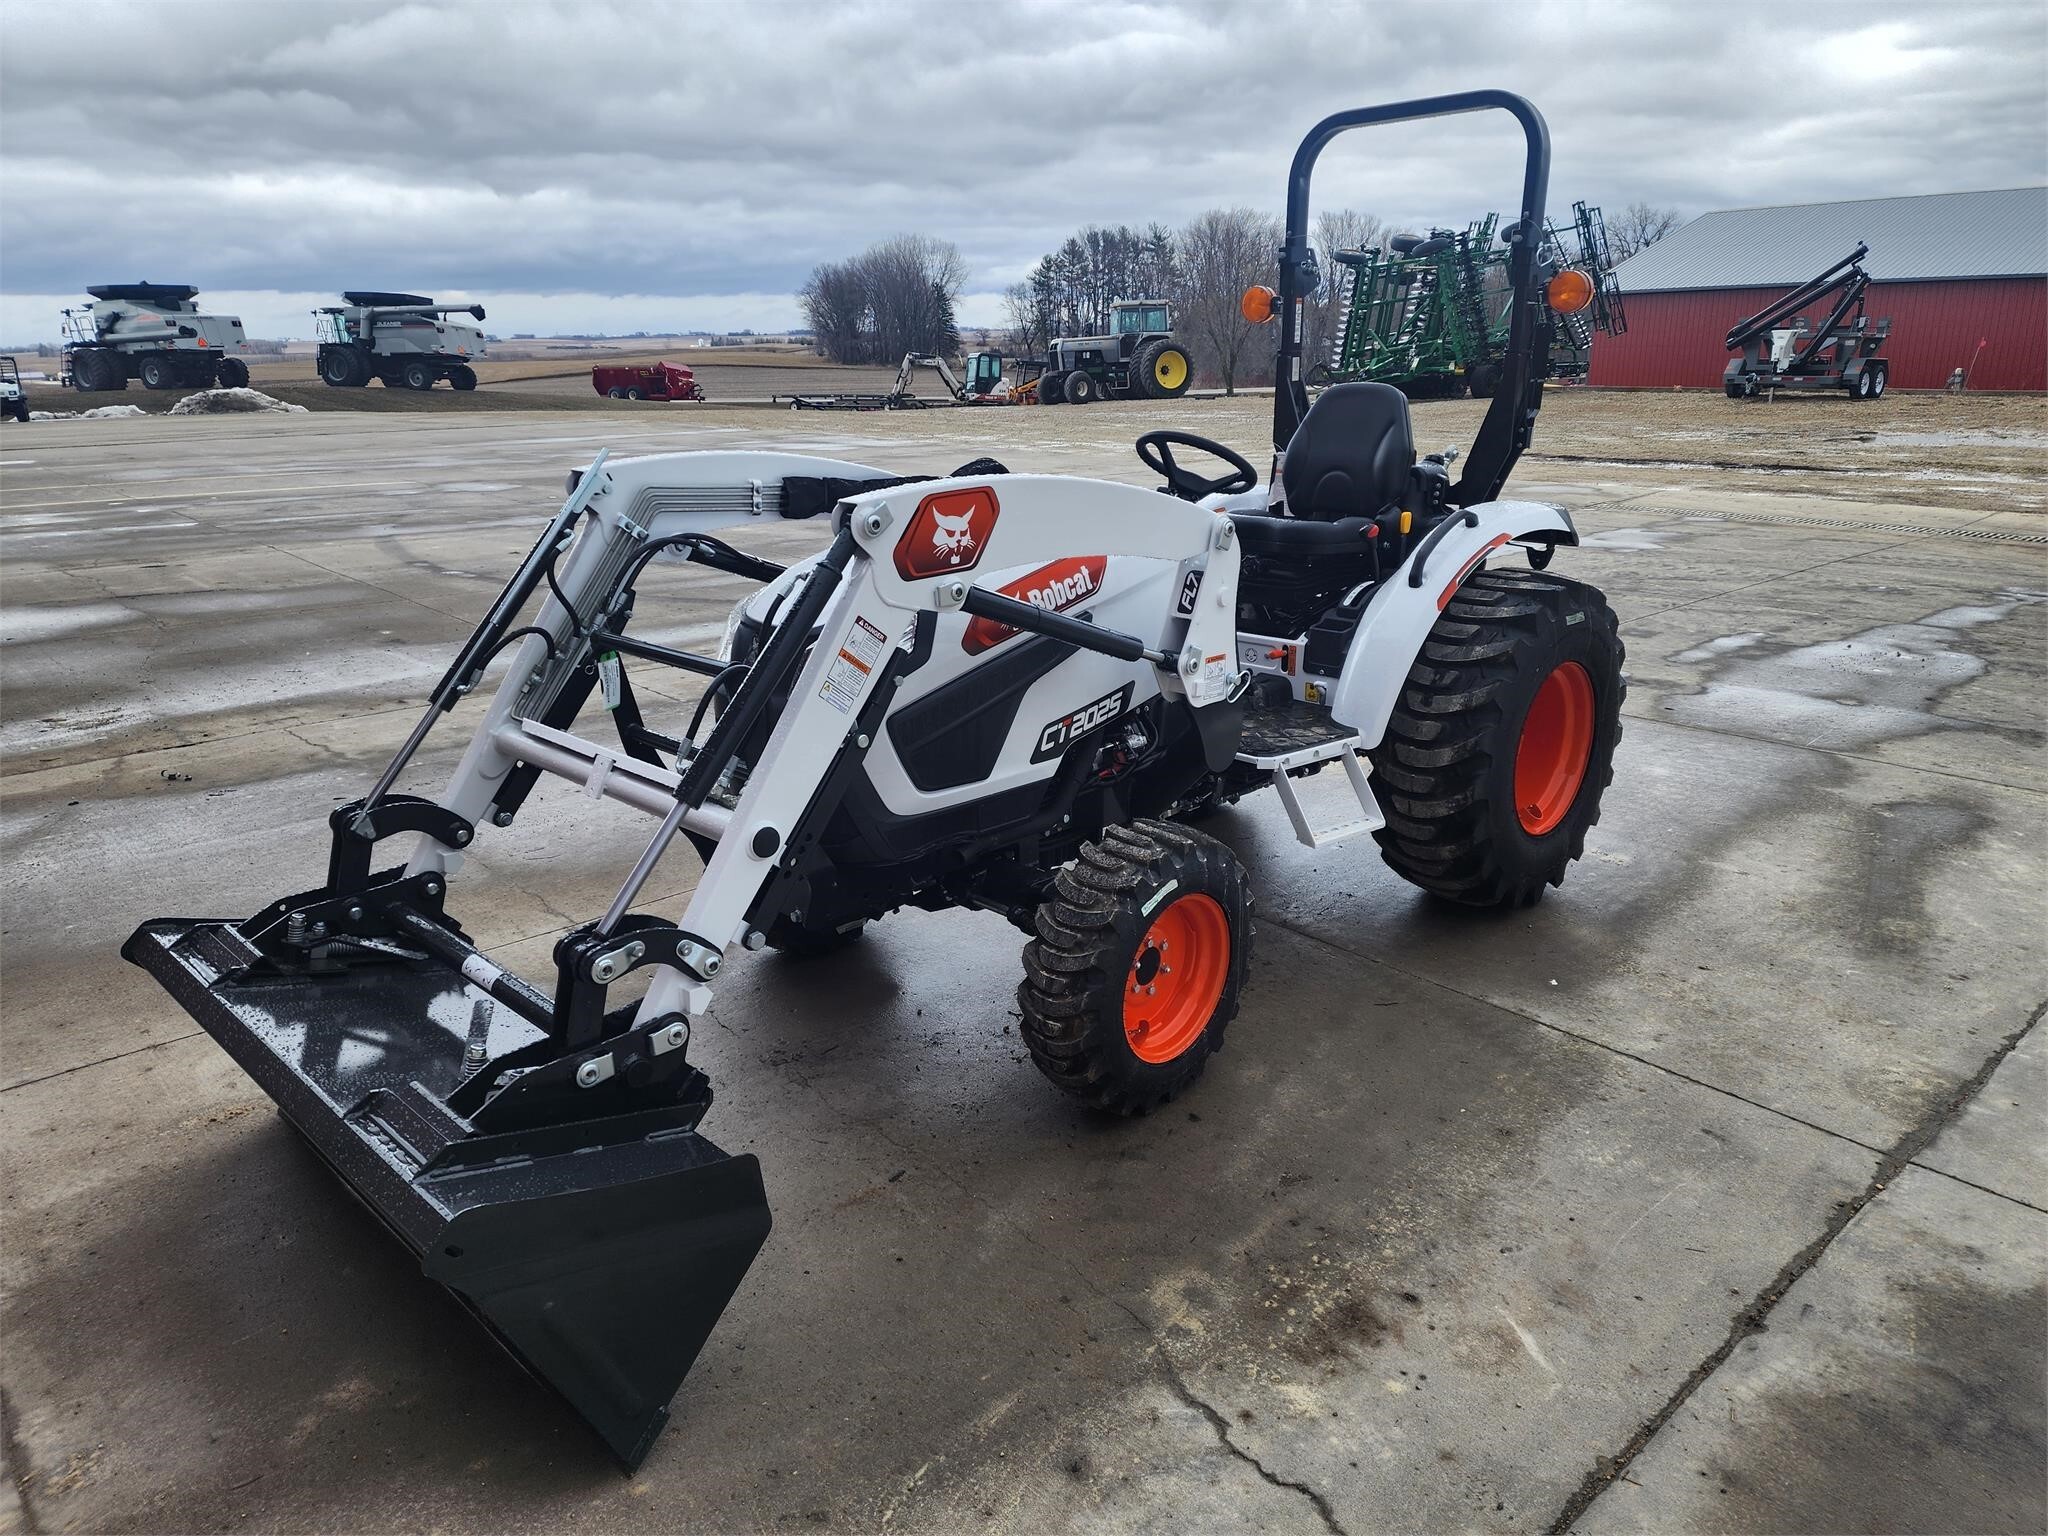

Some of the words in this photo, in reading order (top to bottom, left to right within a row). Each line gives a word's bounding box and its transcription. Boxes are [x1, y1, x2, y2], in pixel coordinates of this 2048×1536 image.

[1027, 565, 1093, 611] Bobcat
[1181, 572, 1198, 611] FL7
[864, 623, 885, 641] DANGER
[1040, 691, 1124, 752] CT2025
